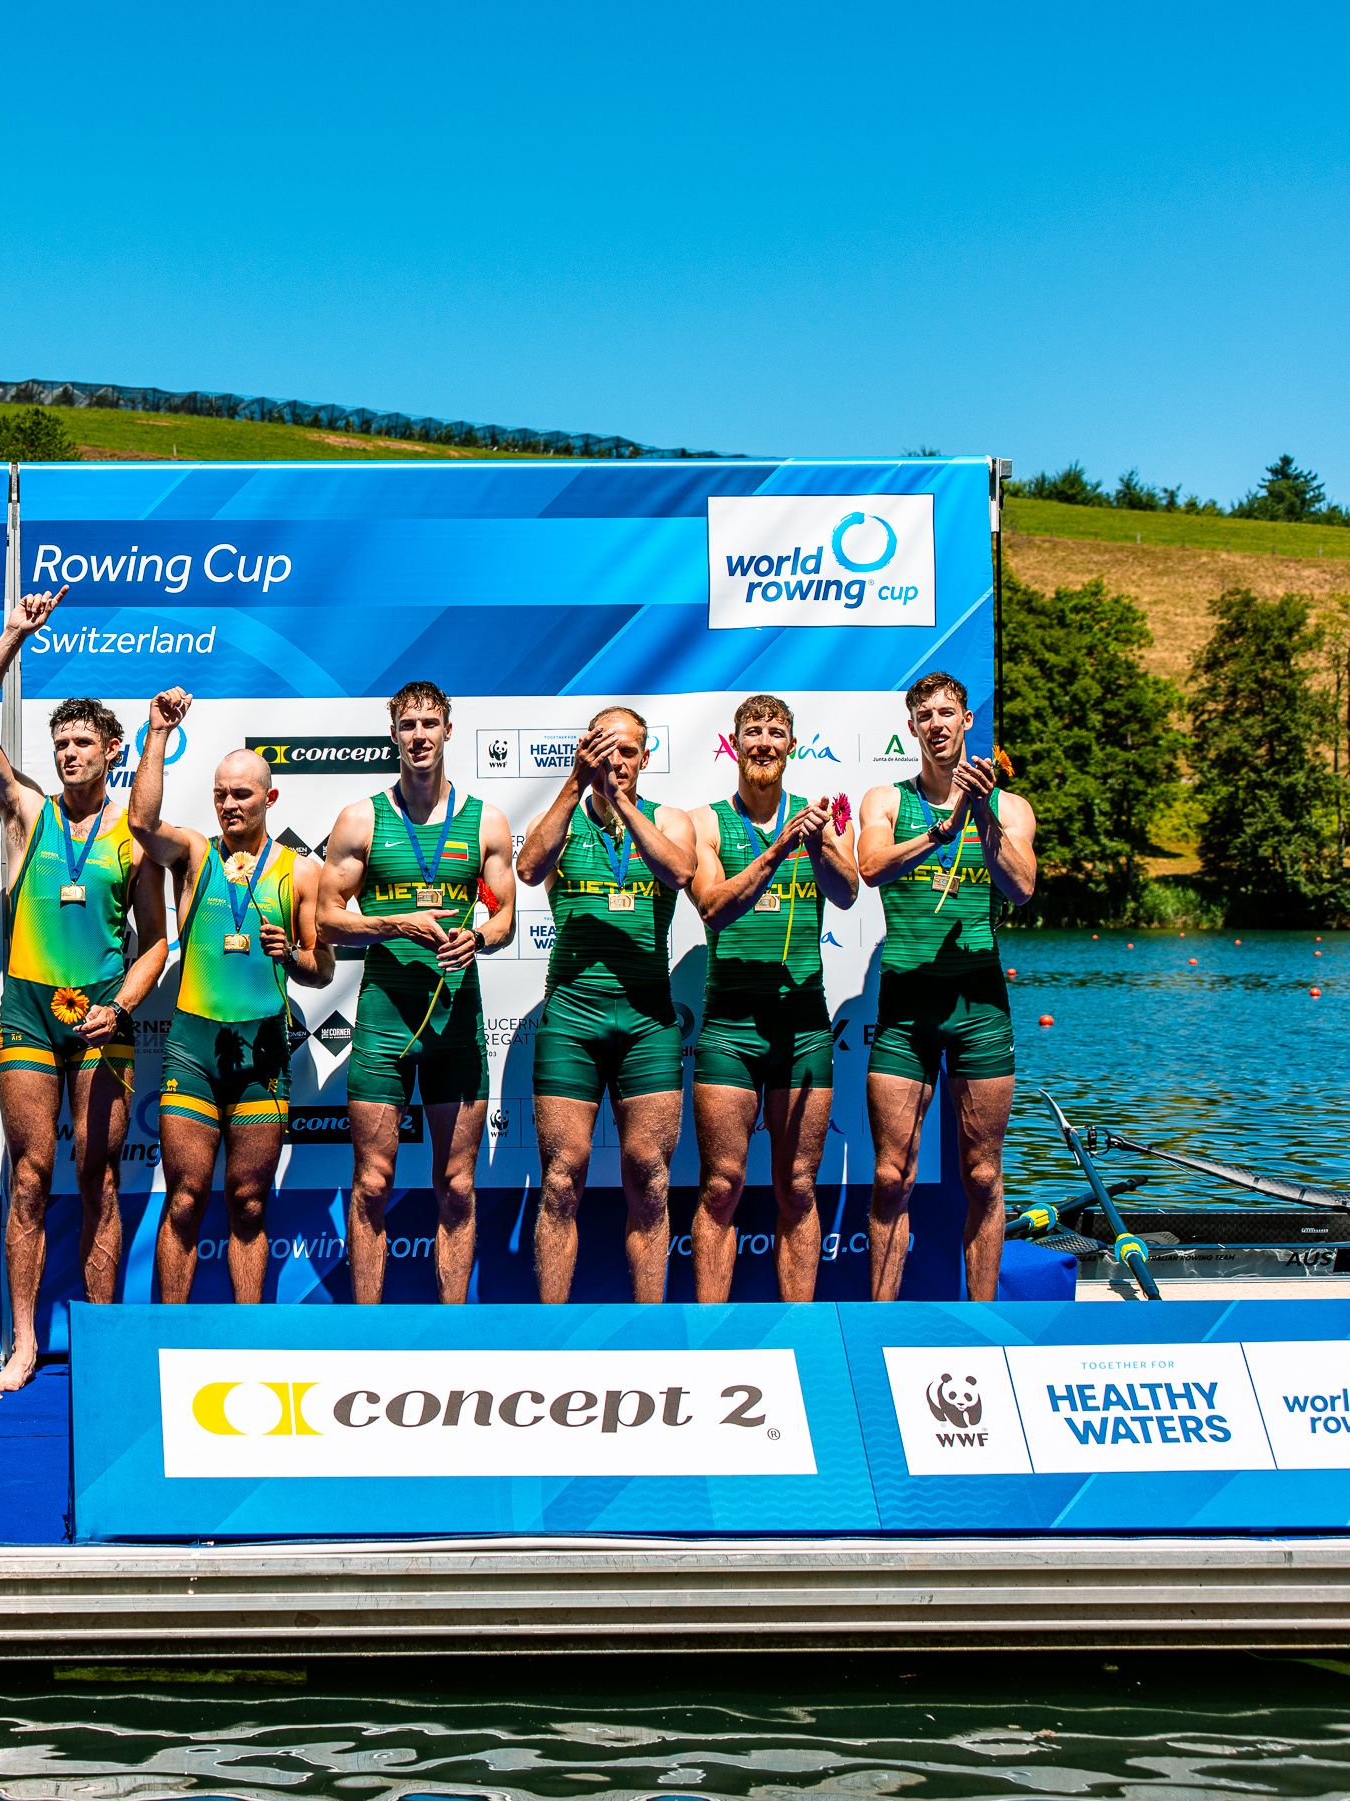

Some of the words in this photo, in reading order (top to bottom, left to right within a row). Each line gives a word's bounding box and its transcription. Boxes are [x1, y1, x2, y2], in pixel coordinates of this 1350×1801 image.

[33, 544, 192, 593] Rowing
[204, 543, 292, 593] Cup
[726, 546, 823, 576] world
[745, 578, 864, 609] rowing
[878, 584, 919, 606] cup
[31, 625, 216, 654] Switzerland
[291, 745, 391, 763] concept
[530, 744, 578, 755] HEALTH
[534, 756, 575, 767] WATE
[899, 864, 992, 884] EUVA
[375, 882, 468, 901] LIETVA
[329, 1028, 351, 1036] CORNER
[483, 1018, 539, 1031] UCERN
[485, 1033, 536, 1045] EGAT
[291, 1116, 350, 1131] conc
[1285, 1251, 1333, 1267] AUS
[1080, 1360, 1147, 1370] TOGETHER
[1151, 1360, 1175, 1369] FOR
[1046, 1381, 1219, 1413] HEALTHY
[1282, 1388, 1350, 1413] worl
[333, 1386, 693, 1433] concept
[719, 1384, 766, 1427] 2
[1063, 1414, 1232, 1445] WATERS
[935, 1432, 989, 1448] WWF
